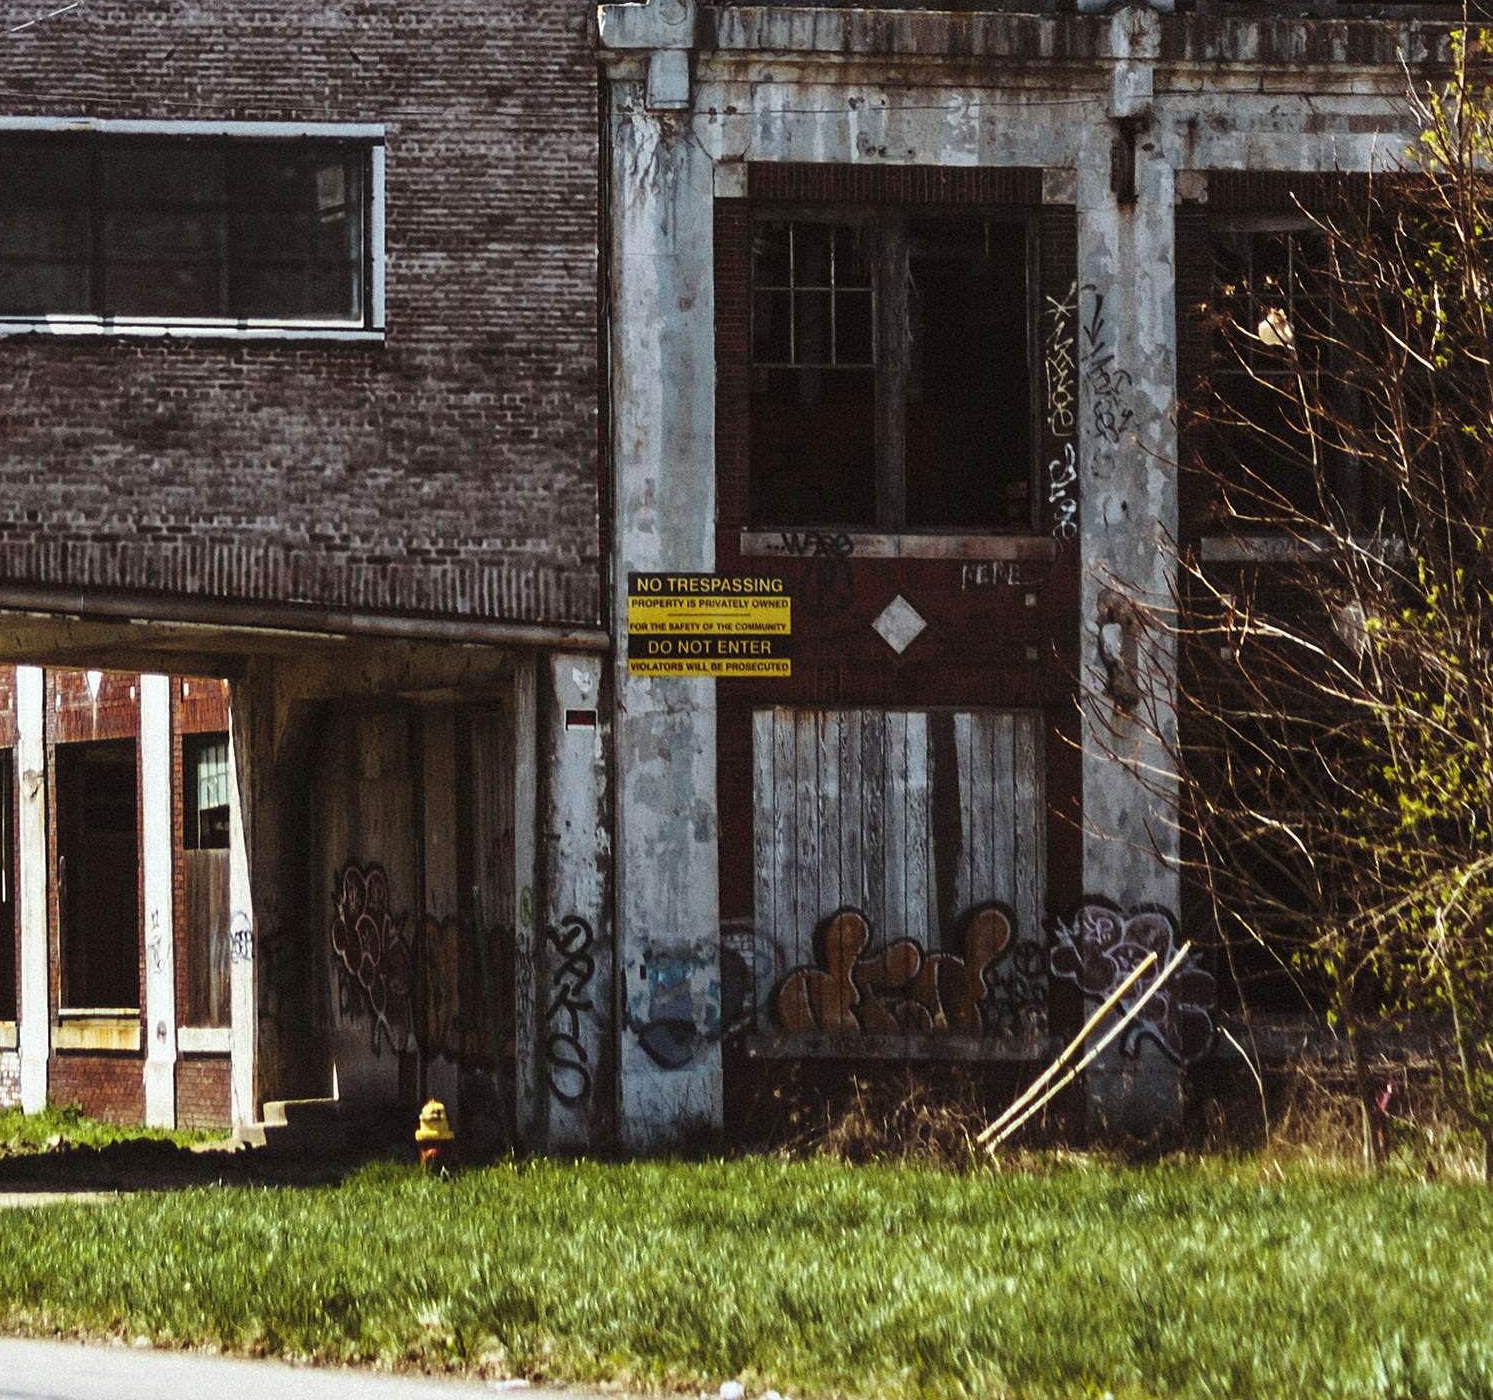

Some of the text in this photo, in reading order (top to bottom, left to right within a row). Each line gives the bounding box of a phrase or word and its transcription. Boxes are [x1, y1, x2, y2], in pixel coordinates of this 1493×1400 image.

[636, 577, 784, 593] NO TRESPASSING
[631, 599, 789, 609] PROPERTY IS PRIVATELY OWNED
[630, 622, 787, 631] FOR THE SAFETY OF THE COMMUNITY
[648, 640, 772, 654] DO NOT ENTER
[630, 663, 789, 672] VIOLATORS WILL BE PROSECUTED
